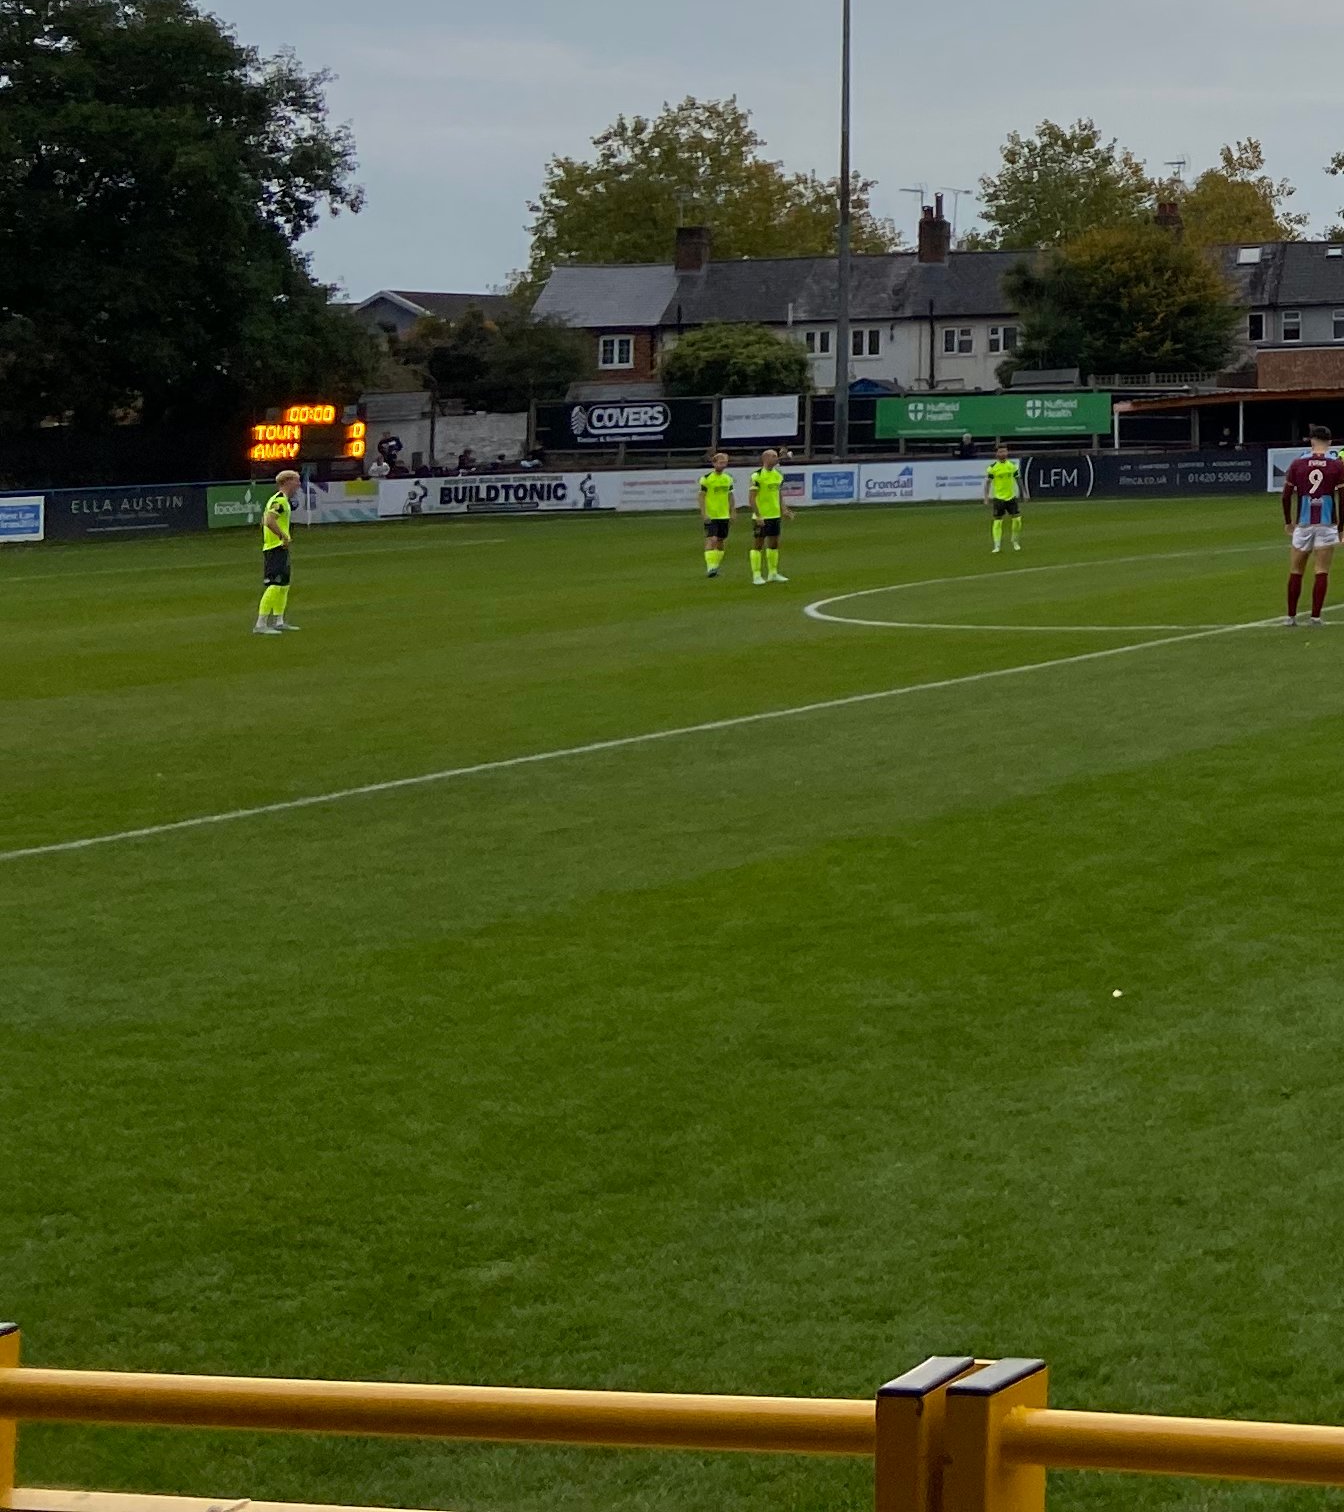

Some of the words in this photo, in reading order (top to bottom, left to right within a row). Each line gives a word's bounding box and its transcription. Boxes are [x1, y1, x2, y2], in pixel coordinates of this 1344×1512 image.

[1044, 399, 1078, 408] Nuffield
[288, 405, 335, 423] 00:00
[592, 406, 665, 428] COVERS
[1044, 409, 1072, 418] Health
[353, 422, 365, 438] 0
[251, 442, 300, 459] AWAY
[352, 440, 365, 457] 0
[1308, 469, 1324, 494] 9
[439, 483, 568, 504] BUILDTONIC
[71, 499, 113, 515] ELLA
[120, 495, 184, 511] AUSTIN
